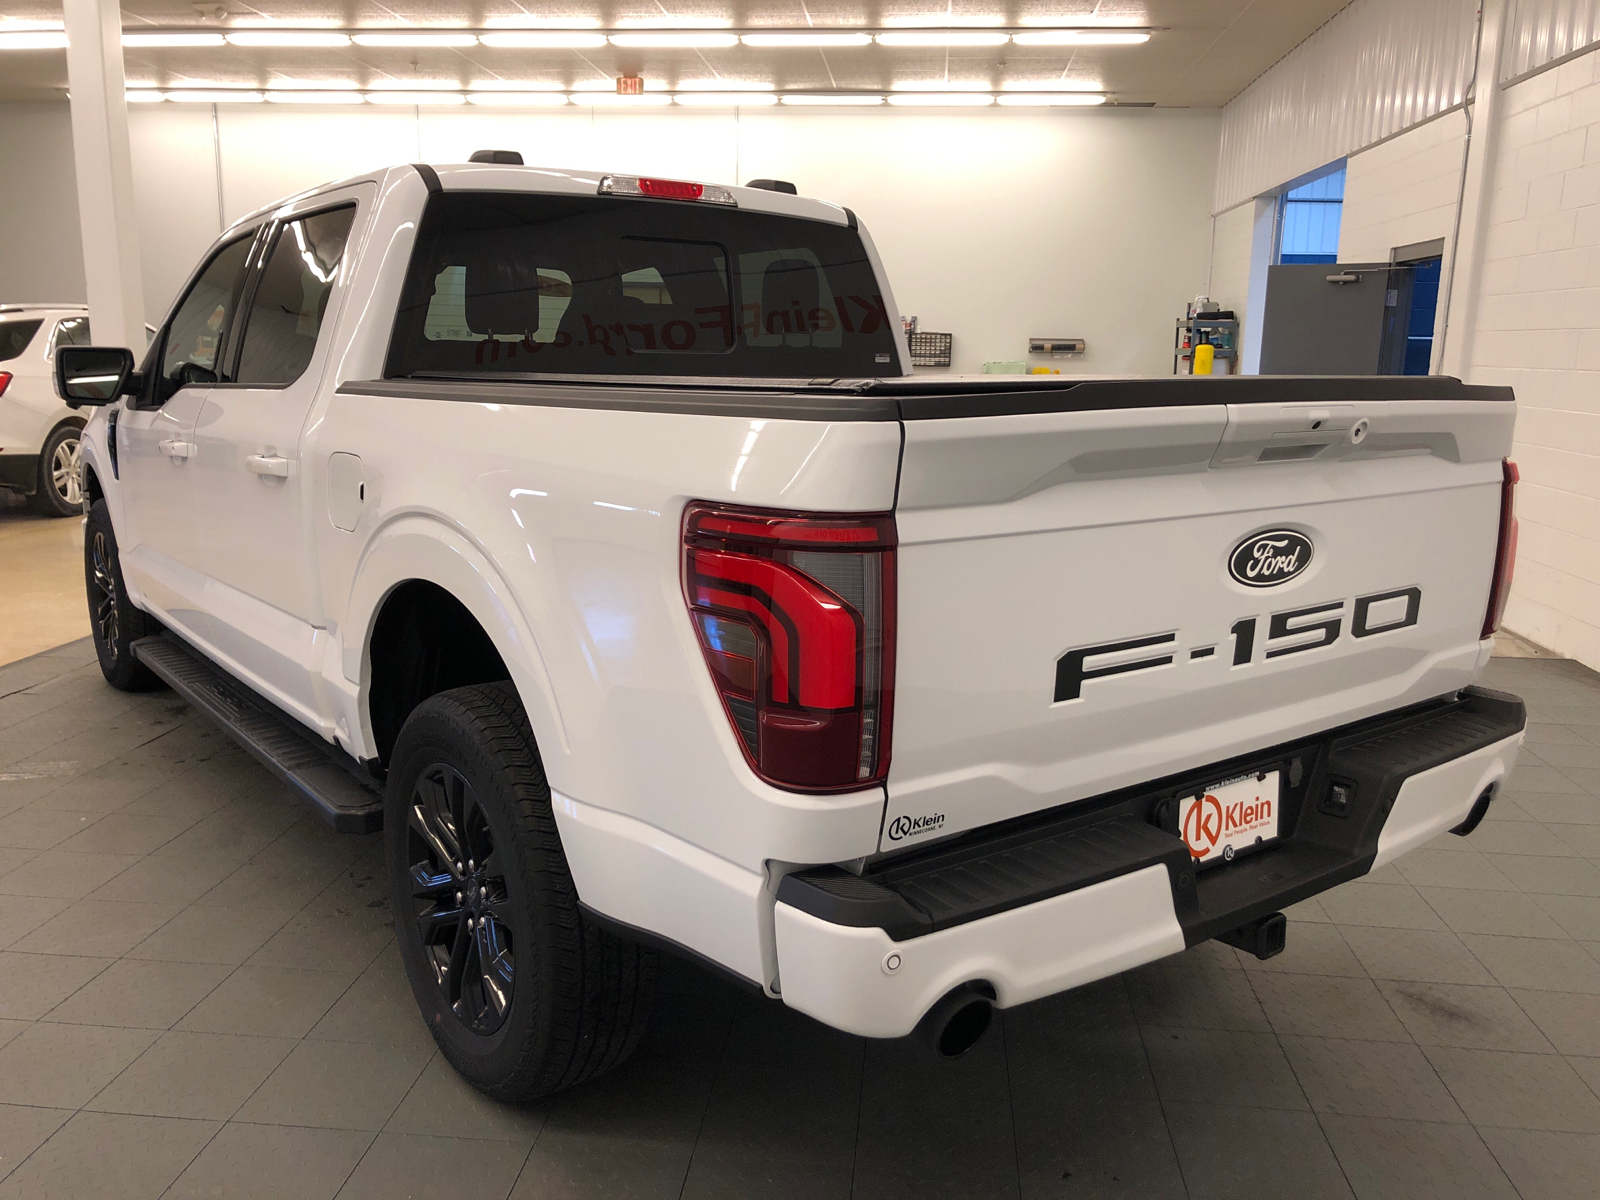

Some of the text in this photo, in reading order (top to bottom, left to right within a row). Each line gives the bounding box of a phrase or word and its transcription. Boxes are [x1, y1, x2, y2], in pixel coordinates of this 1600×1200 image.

[620, 77, 640, 95] EXIT
[1245, 538, 1302, 578] Ford
[1053, 586, 1422, 704] F-150
[1205, 771, 1260, 791] www.kleinauto.com
[912, 812, 945, 830] Klein
[1224, 796, 1272, 831] Klein
